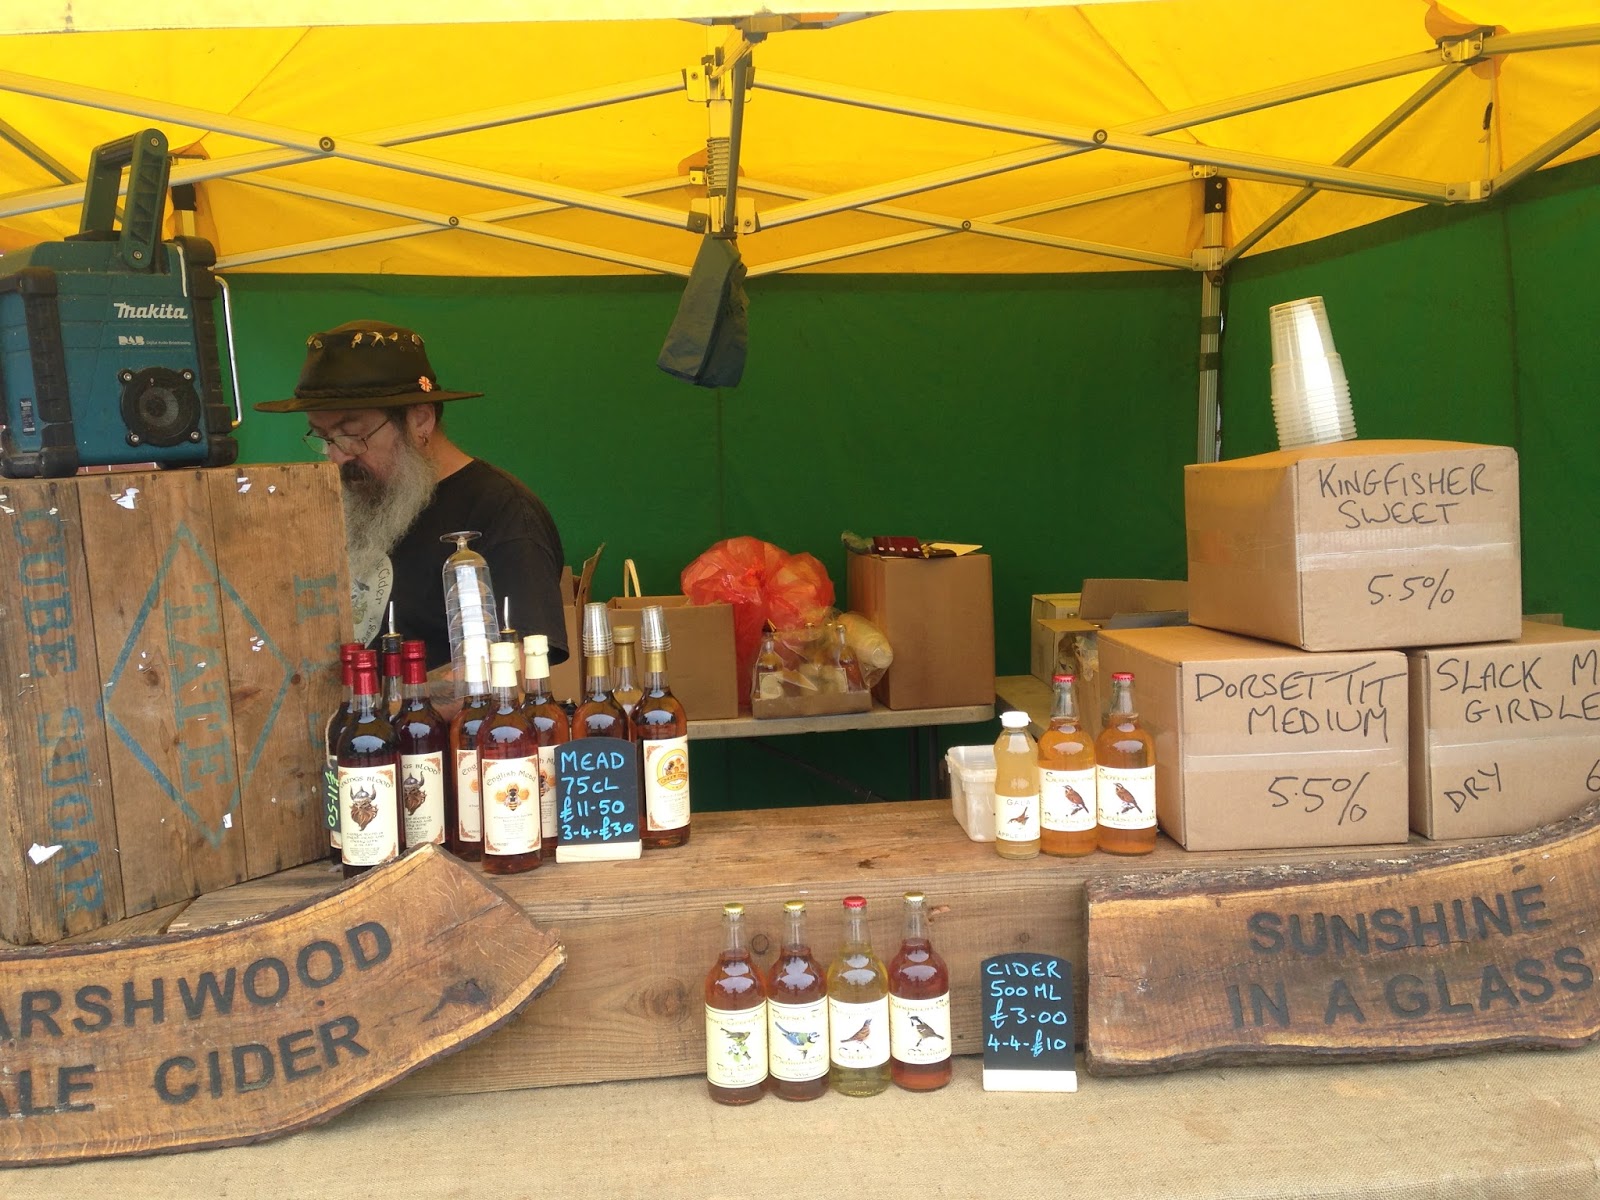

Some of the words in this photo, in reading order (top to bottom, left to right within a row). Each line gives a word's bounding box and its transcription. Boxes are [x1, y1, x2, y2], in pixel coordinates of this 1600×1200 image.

[118, 335, 145, 346] DAB
[1319, 463, 1493, 498] KINGFISHER
[1338, 500, 1459, 529] SWEET
[14, 509, 79, 678] CUBE
[1367, 569, 1455, 610] 5.5%
[164, 585, 236, 794] TATE
[1195, 671, 1340, 702] DORSET
[1325, 661, 1407, 707] TIT
[1437, 656, 1543, 694] SLACK
[1248, 705, 1389, 743] MEDIUM
[1465, 692, 1600, 724] GIRDLE
[487, 770, 516, 787] English
[561, 751, 625, 773] MEAD
[1268, 772, 1371, 826] 5.5%
[1444, 762, 1502, 814] DRY
[38, 706, 105, 918] SUGAR
[1247, 884, 1553, 956] SUNSHINE
[0, 920, 393, 1041] RSHWOOD
[986, 960, 1062, 979] CIDER
[990, 980, 1028, 997] 500
[1034, 983, 1062, 1000] ML
[1227, 980, 1291, 1029] IN
[1324, 979, 1366, 1025] A
[1387, 946, 1595, 1020] GLASS
[0, 1063, 96, 1119] LE
[154, 1015, 369, 1106] CIDER
